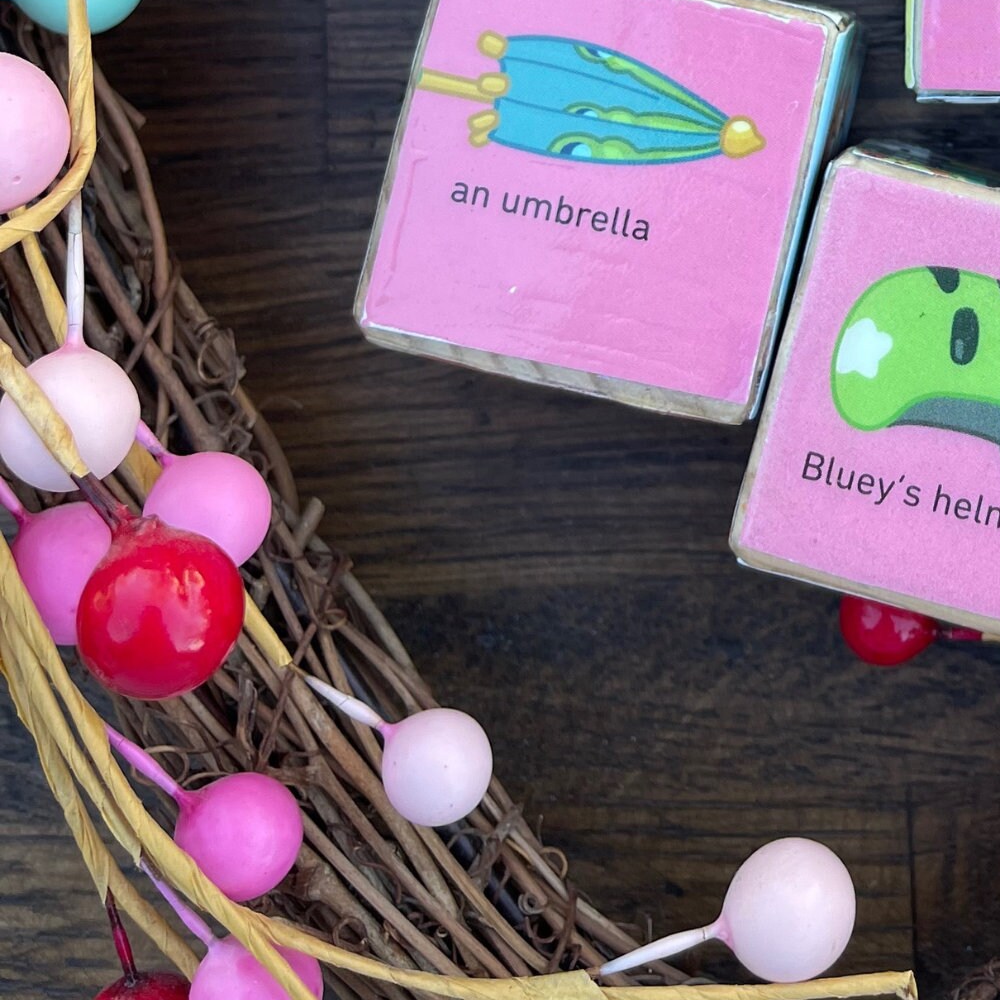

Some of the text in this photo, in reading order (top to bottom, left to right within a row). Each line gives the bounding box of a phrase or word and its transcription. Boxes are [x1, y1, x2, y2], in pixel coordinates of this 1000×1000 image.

[450, 181, 650, 241] an umbrella
[801, 450, 921, 507] Bluey's
